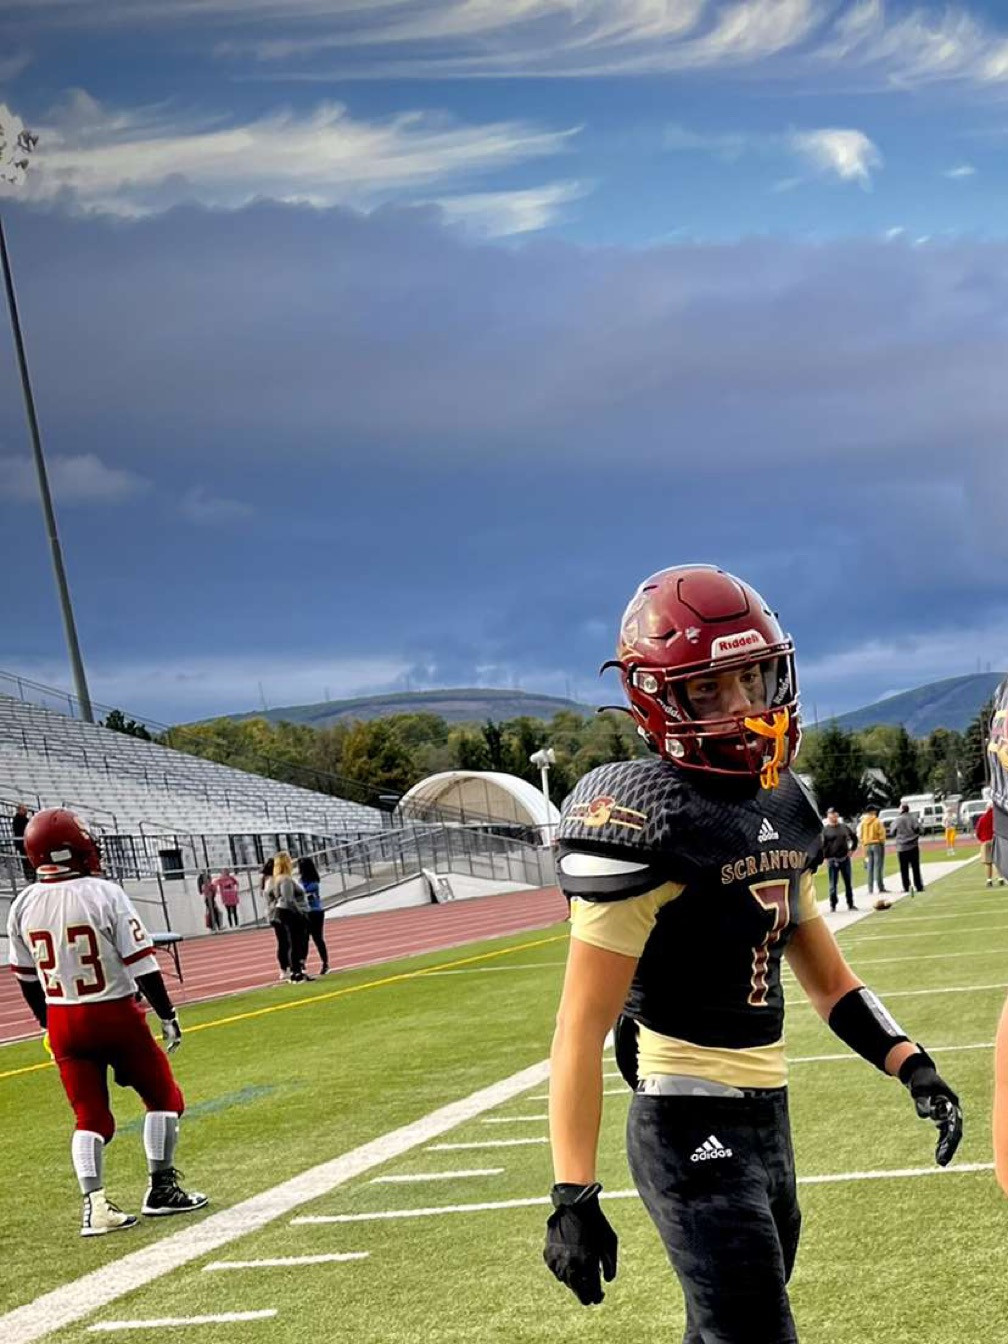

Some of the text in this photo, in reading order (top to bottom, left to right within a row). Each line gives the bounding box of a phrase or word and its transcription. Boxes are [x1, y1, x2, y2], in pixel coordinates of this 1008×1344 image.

[719, 633, 759, 651] Riddell
[28, 924, 106, 997] 23
[749, 879, 790, 1008] 7
[690, 1148, 732, 1162] adidas
